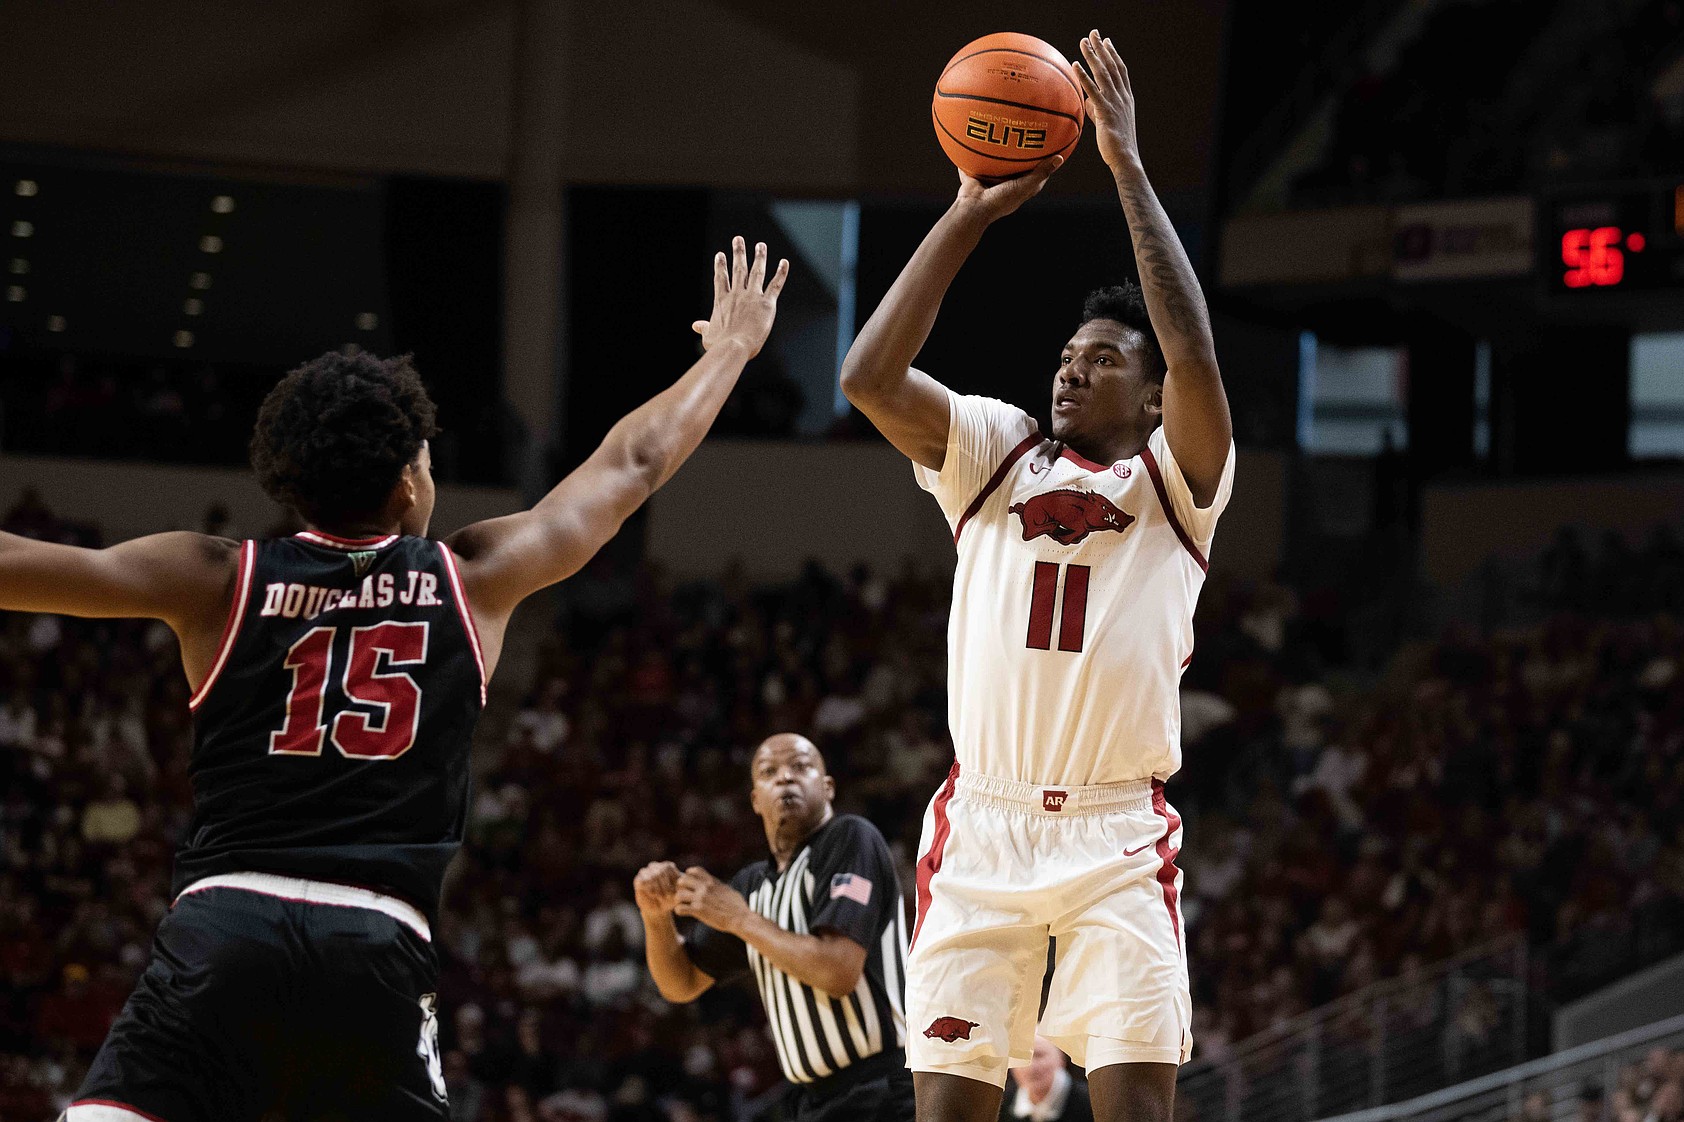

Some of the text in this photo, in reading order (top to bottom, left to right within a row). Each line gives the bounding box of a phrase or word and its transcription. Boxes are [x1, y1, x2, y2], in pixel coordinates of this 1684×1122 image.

[966, 116, 1047, 149] ELITE
[1114, 465, 1131, 478] SEC
[399, 571, 443, 606] JR.
[1026, 561, 1091, 653] 11
[268, 620, 430, 761] 15
[1045, 796, 1064, 806] AR
